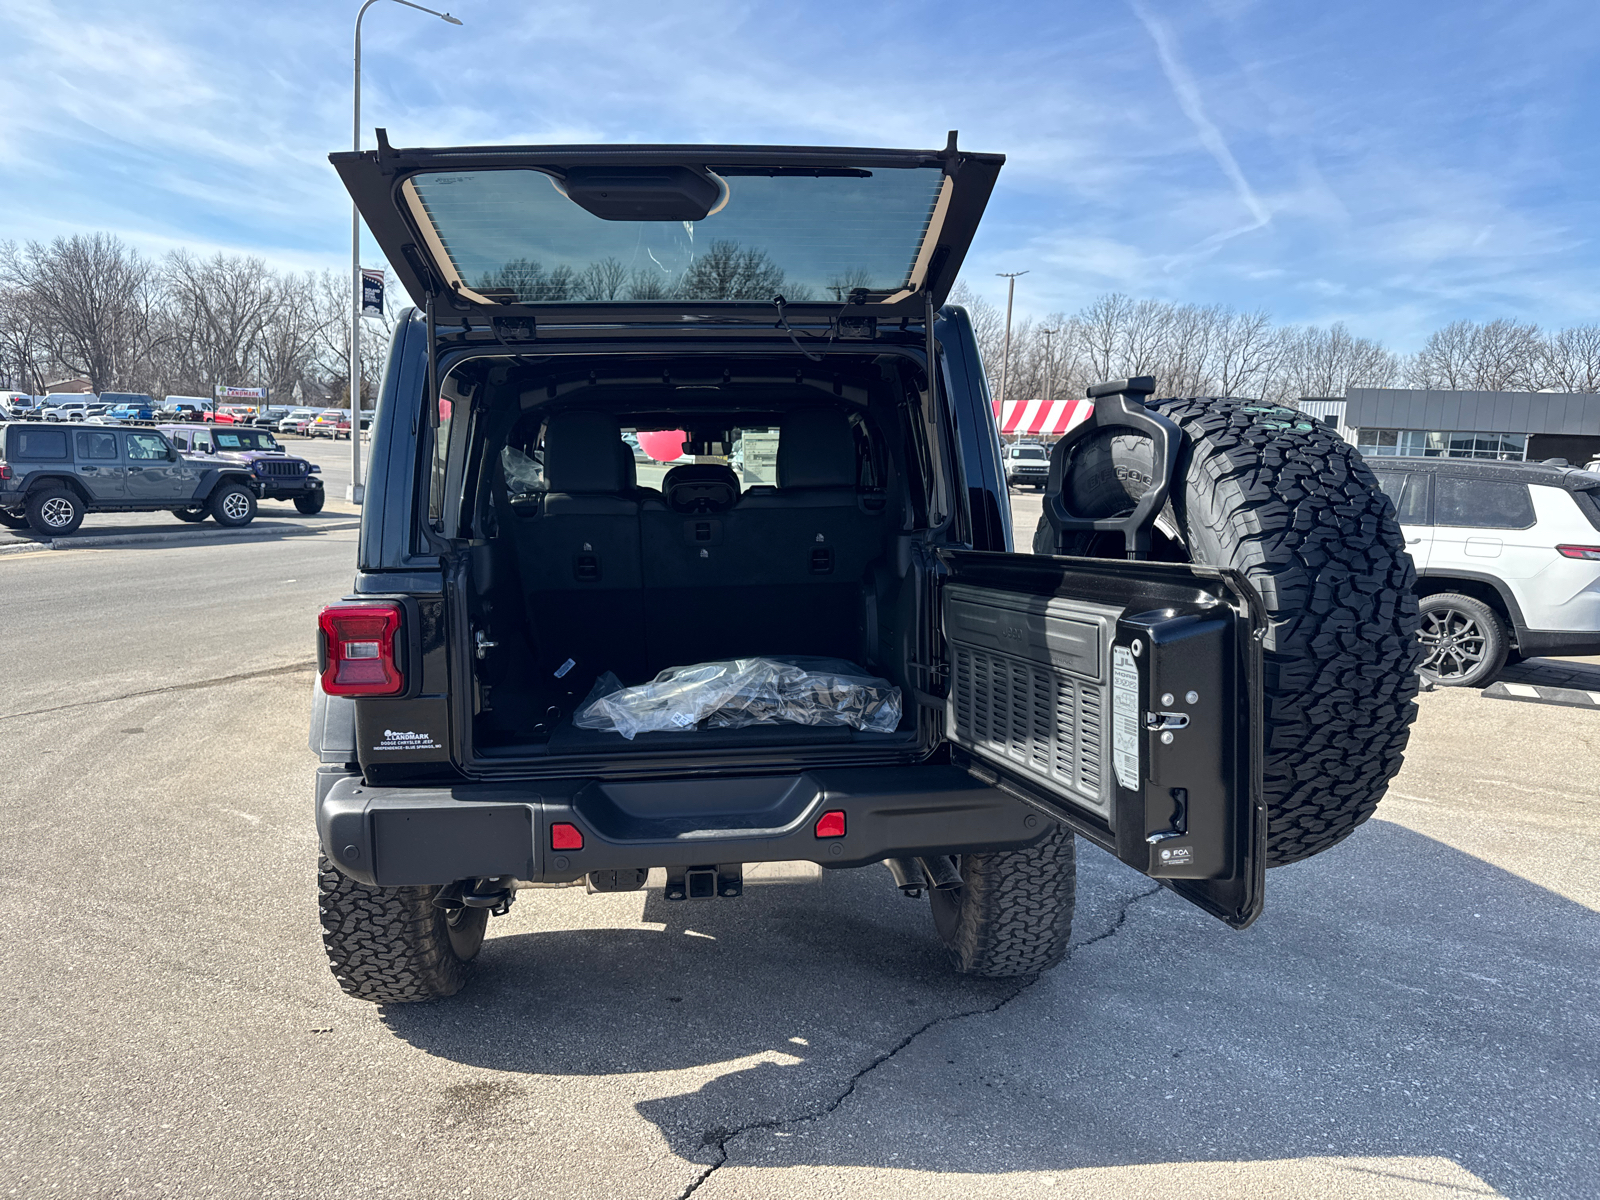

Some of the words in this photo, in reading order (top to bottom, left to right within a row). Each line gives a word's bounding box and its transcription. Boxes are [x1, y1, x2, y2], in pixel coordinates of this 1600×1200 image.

[1002, 626, 1022, 642] Jeep
[1116, 658, 1134, 667] JL
[1114, 671, 1136, 680] MOAB
